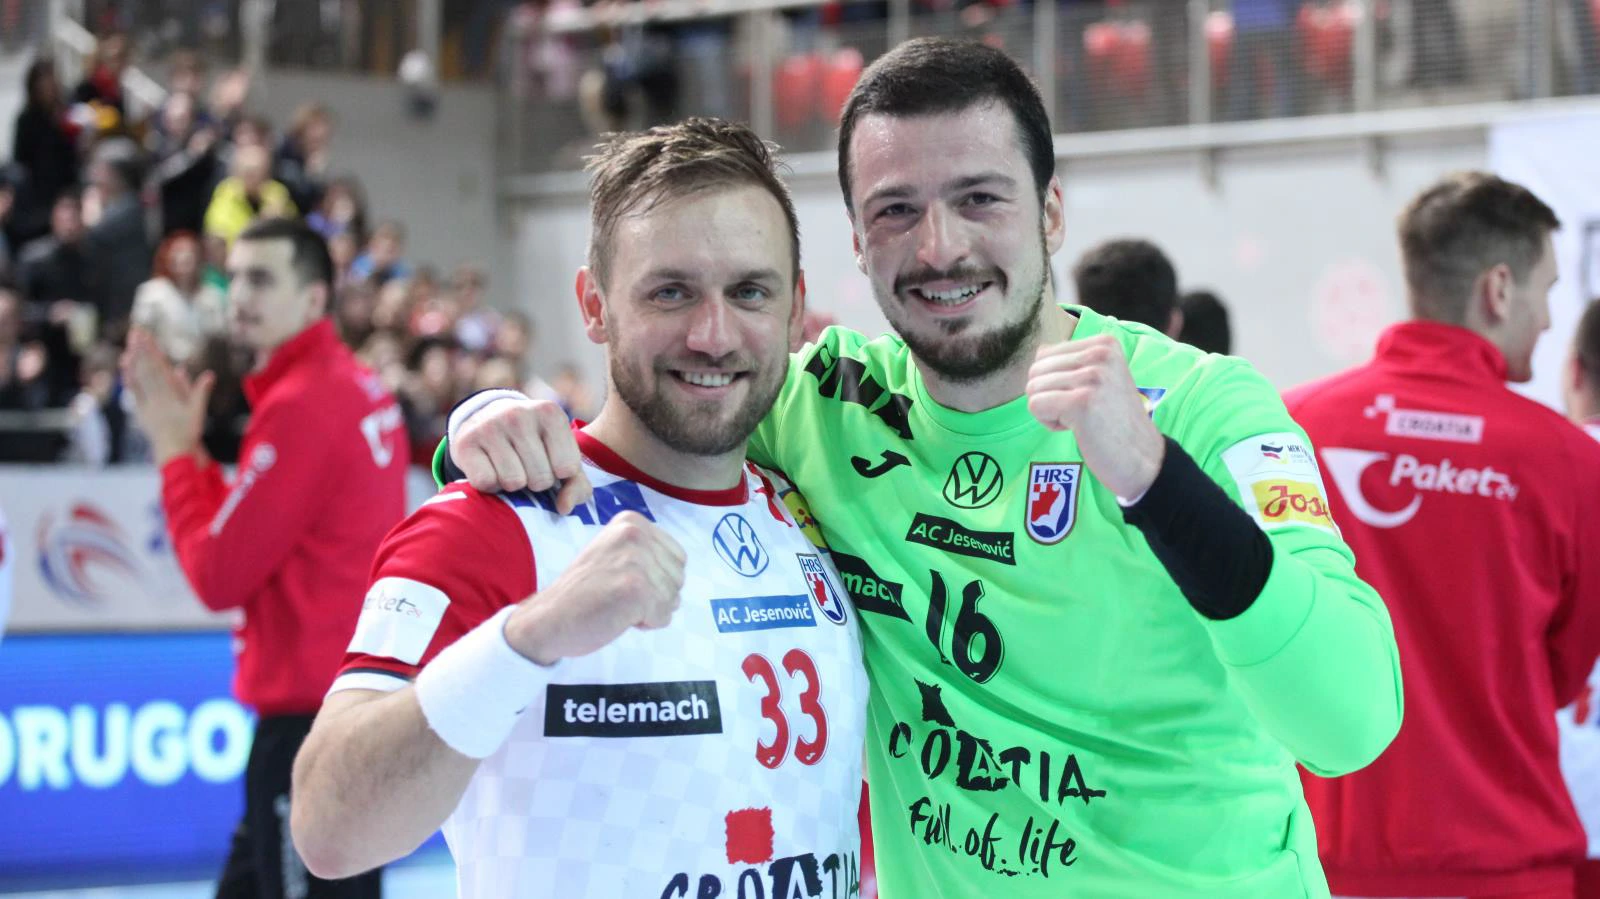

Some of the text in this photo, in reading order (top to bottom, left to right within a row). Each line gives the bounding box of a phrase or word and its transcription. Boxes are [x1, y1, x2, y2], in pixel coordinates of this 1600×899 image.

[1034, 468, 1074, 484] HRS
[911, 522, 1012, 558] AC Jesenović
[801, 558, 824, 573] HRS
[717, 602, 812, 626] AC Jesenović
[926, 568, 1005, 684] 16
[563, 694, 709, 723] telemach
[741, 648, 830, 770] 33
[889, 722, 1106, 806] COATIA
[909, 796, 1079, 878] Full of life
